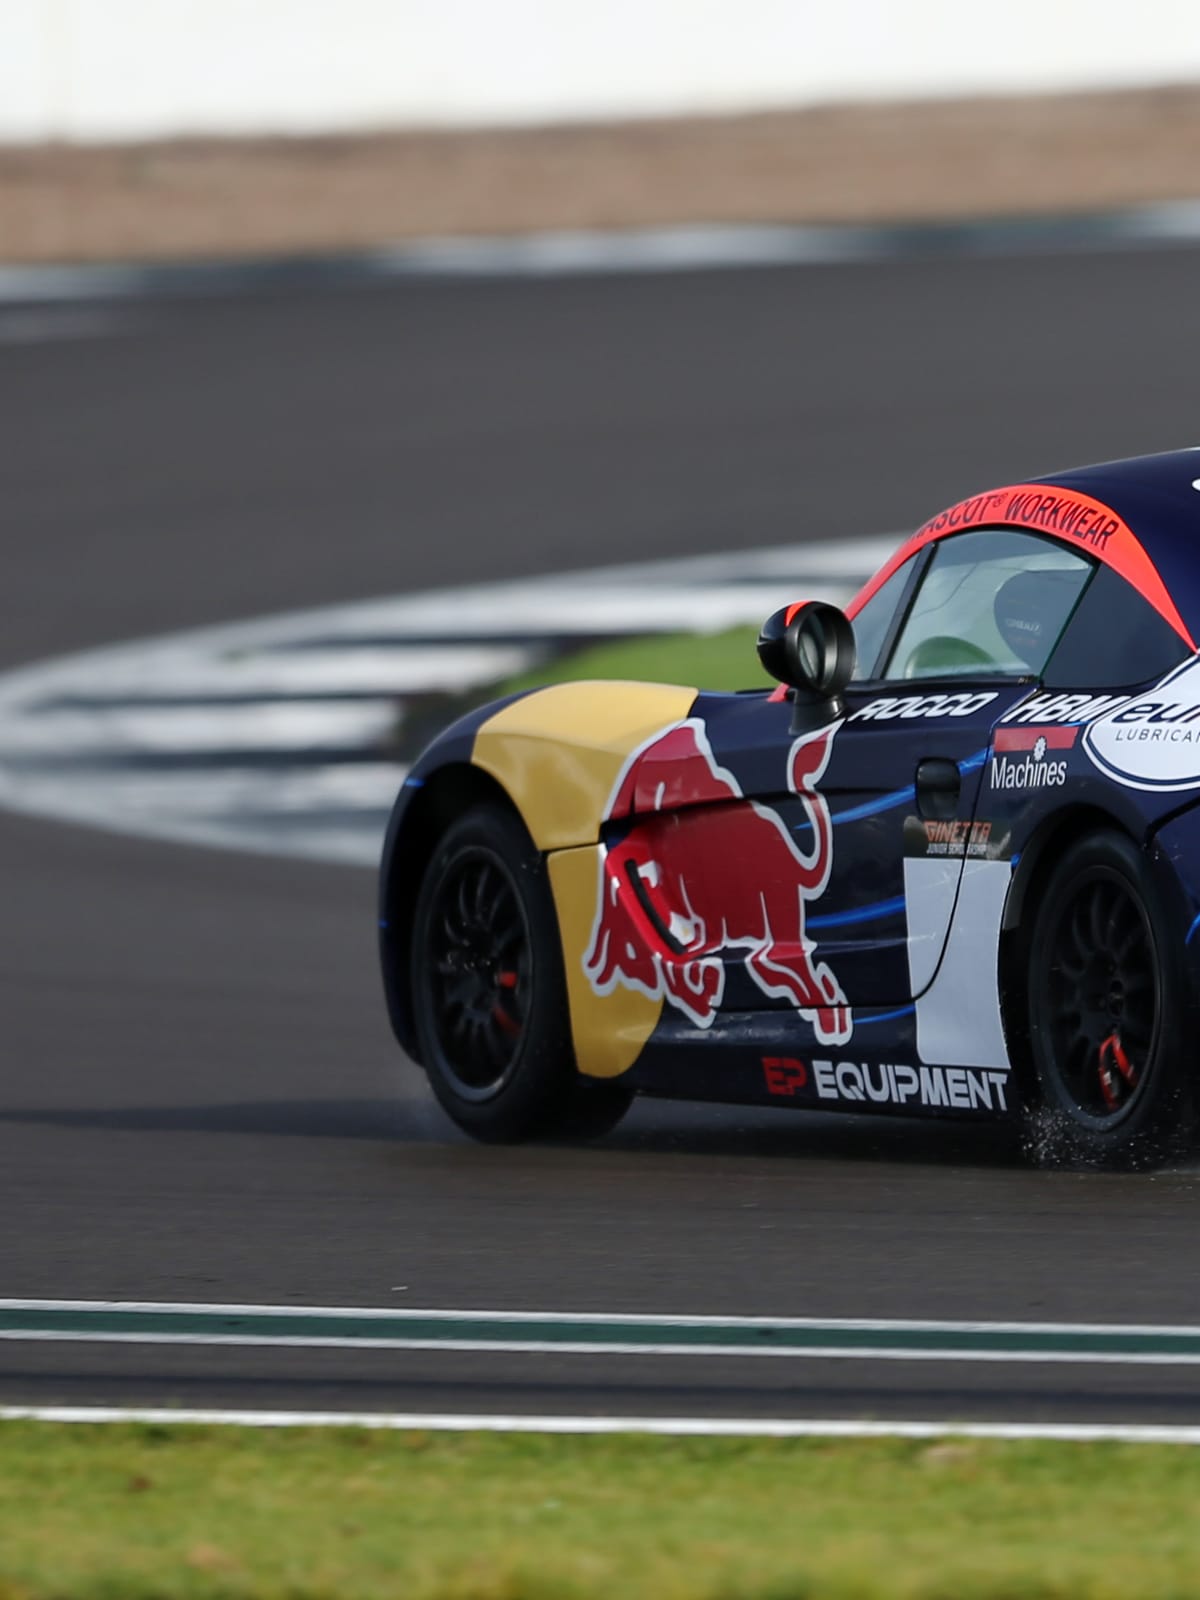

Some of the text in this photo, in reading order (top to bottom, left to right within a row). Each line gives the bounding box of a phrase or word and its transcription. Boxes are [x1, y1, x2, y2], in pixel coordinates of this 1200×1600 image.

[1004, 493, 1119, 551] WORKWEAR
[848, 692, 999, 722] ROCCO
[991, 755, 1067, 790] Machines
[812, 1060, 1008, 1111] EQUIPMENT
